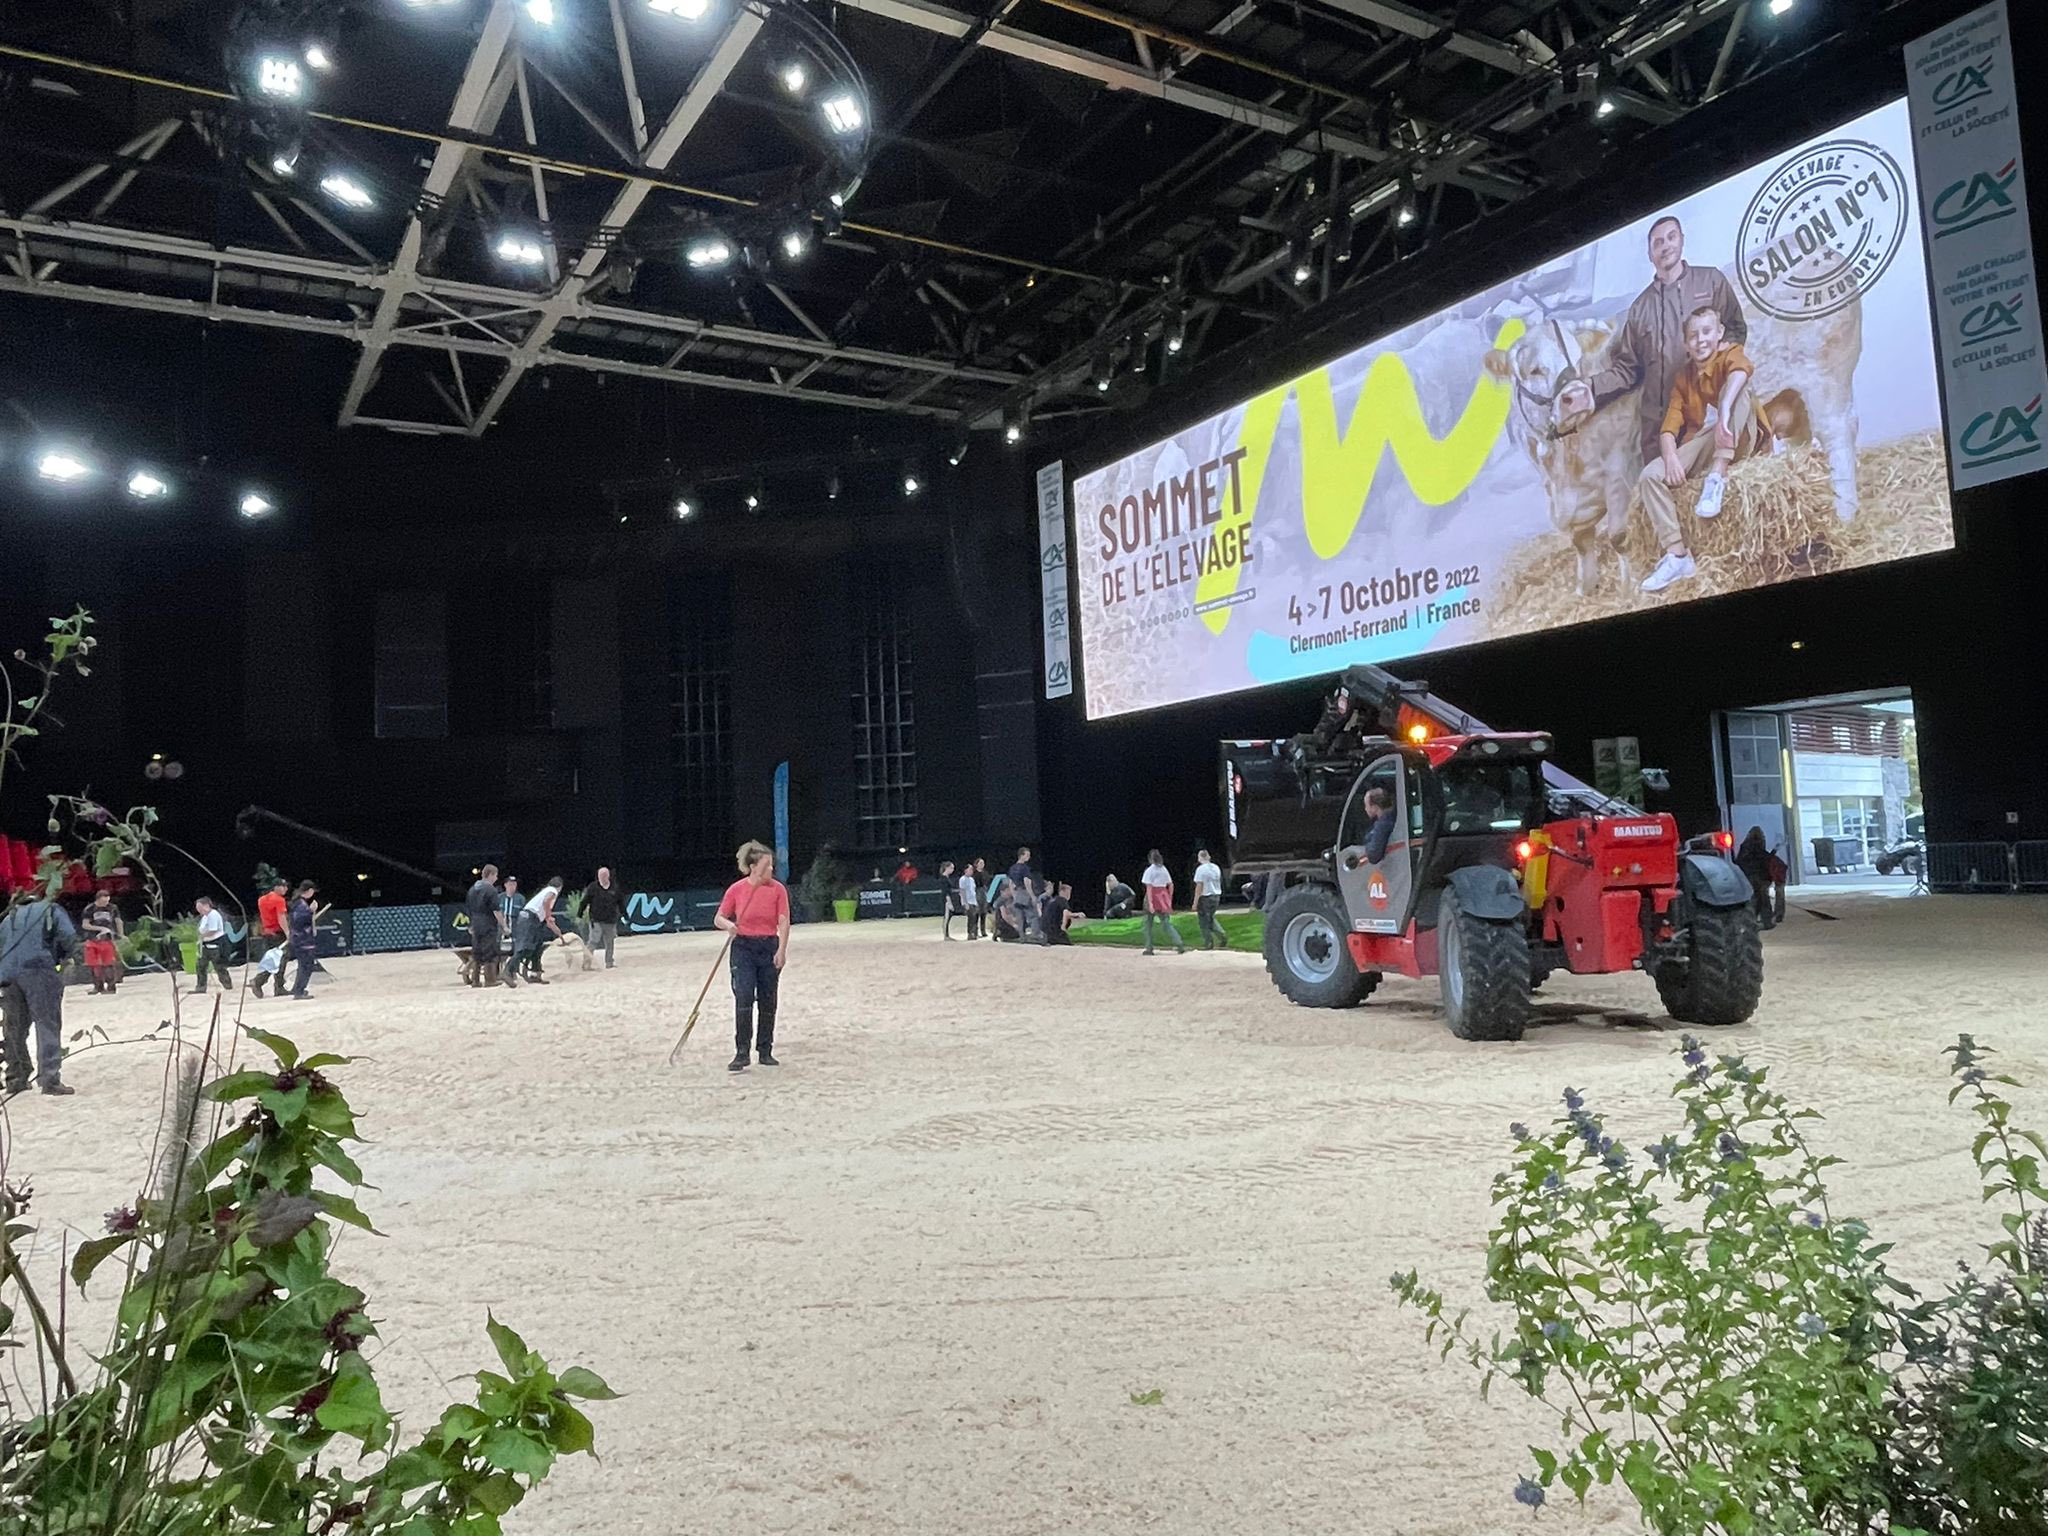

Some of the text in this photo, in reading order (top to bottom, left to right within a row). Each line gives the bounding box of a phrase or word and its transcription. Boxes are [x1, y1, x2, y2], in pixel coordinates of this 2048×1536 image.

[1953, 127, 1965, 138] LA
[1755, 206, 1773, 225] DE
[1750, 208, 1837, 289] SALON
[1803, 249, 1880, 307] EN EUROPE
[1950, 288, 1984, 306] VOTRE
[1962, 348, 1991, 363] CELUI
[1980, 361, 1993, 371] LA
[1099, 446, 1247, 561] SOMMET
[1102, 567, 1126, 607] DE
[1340, 567, 1439, 614] Octobre
[1445, 565, 1480, 590] 2022
[1290, 598, 1481, 654] Clermont-Ferrand France
[1614, 825, 1663, 837] MANITOU
[1370, 882, 1387, 898] AL
